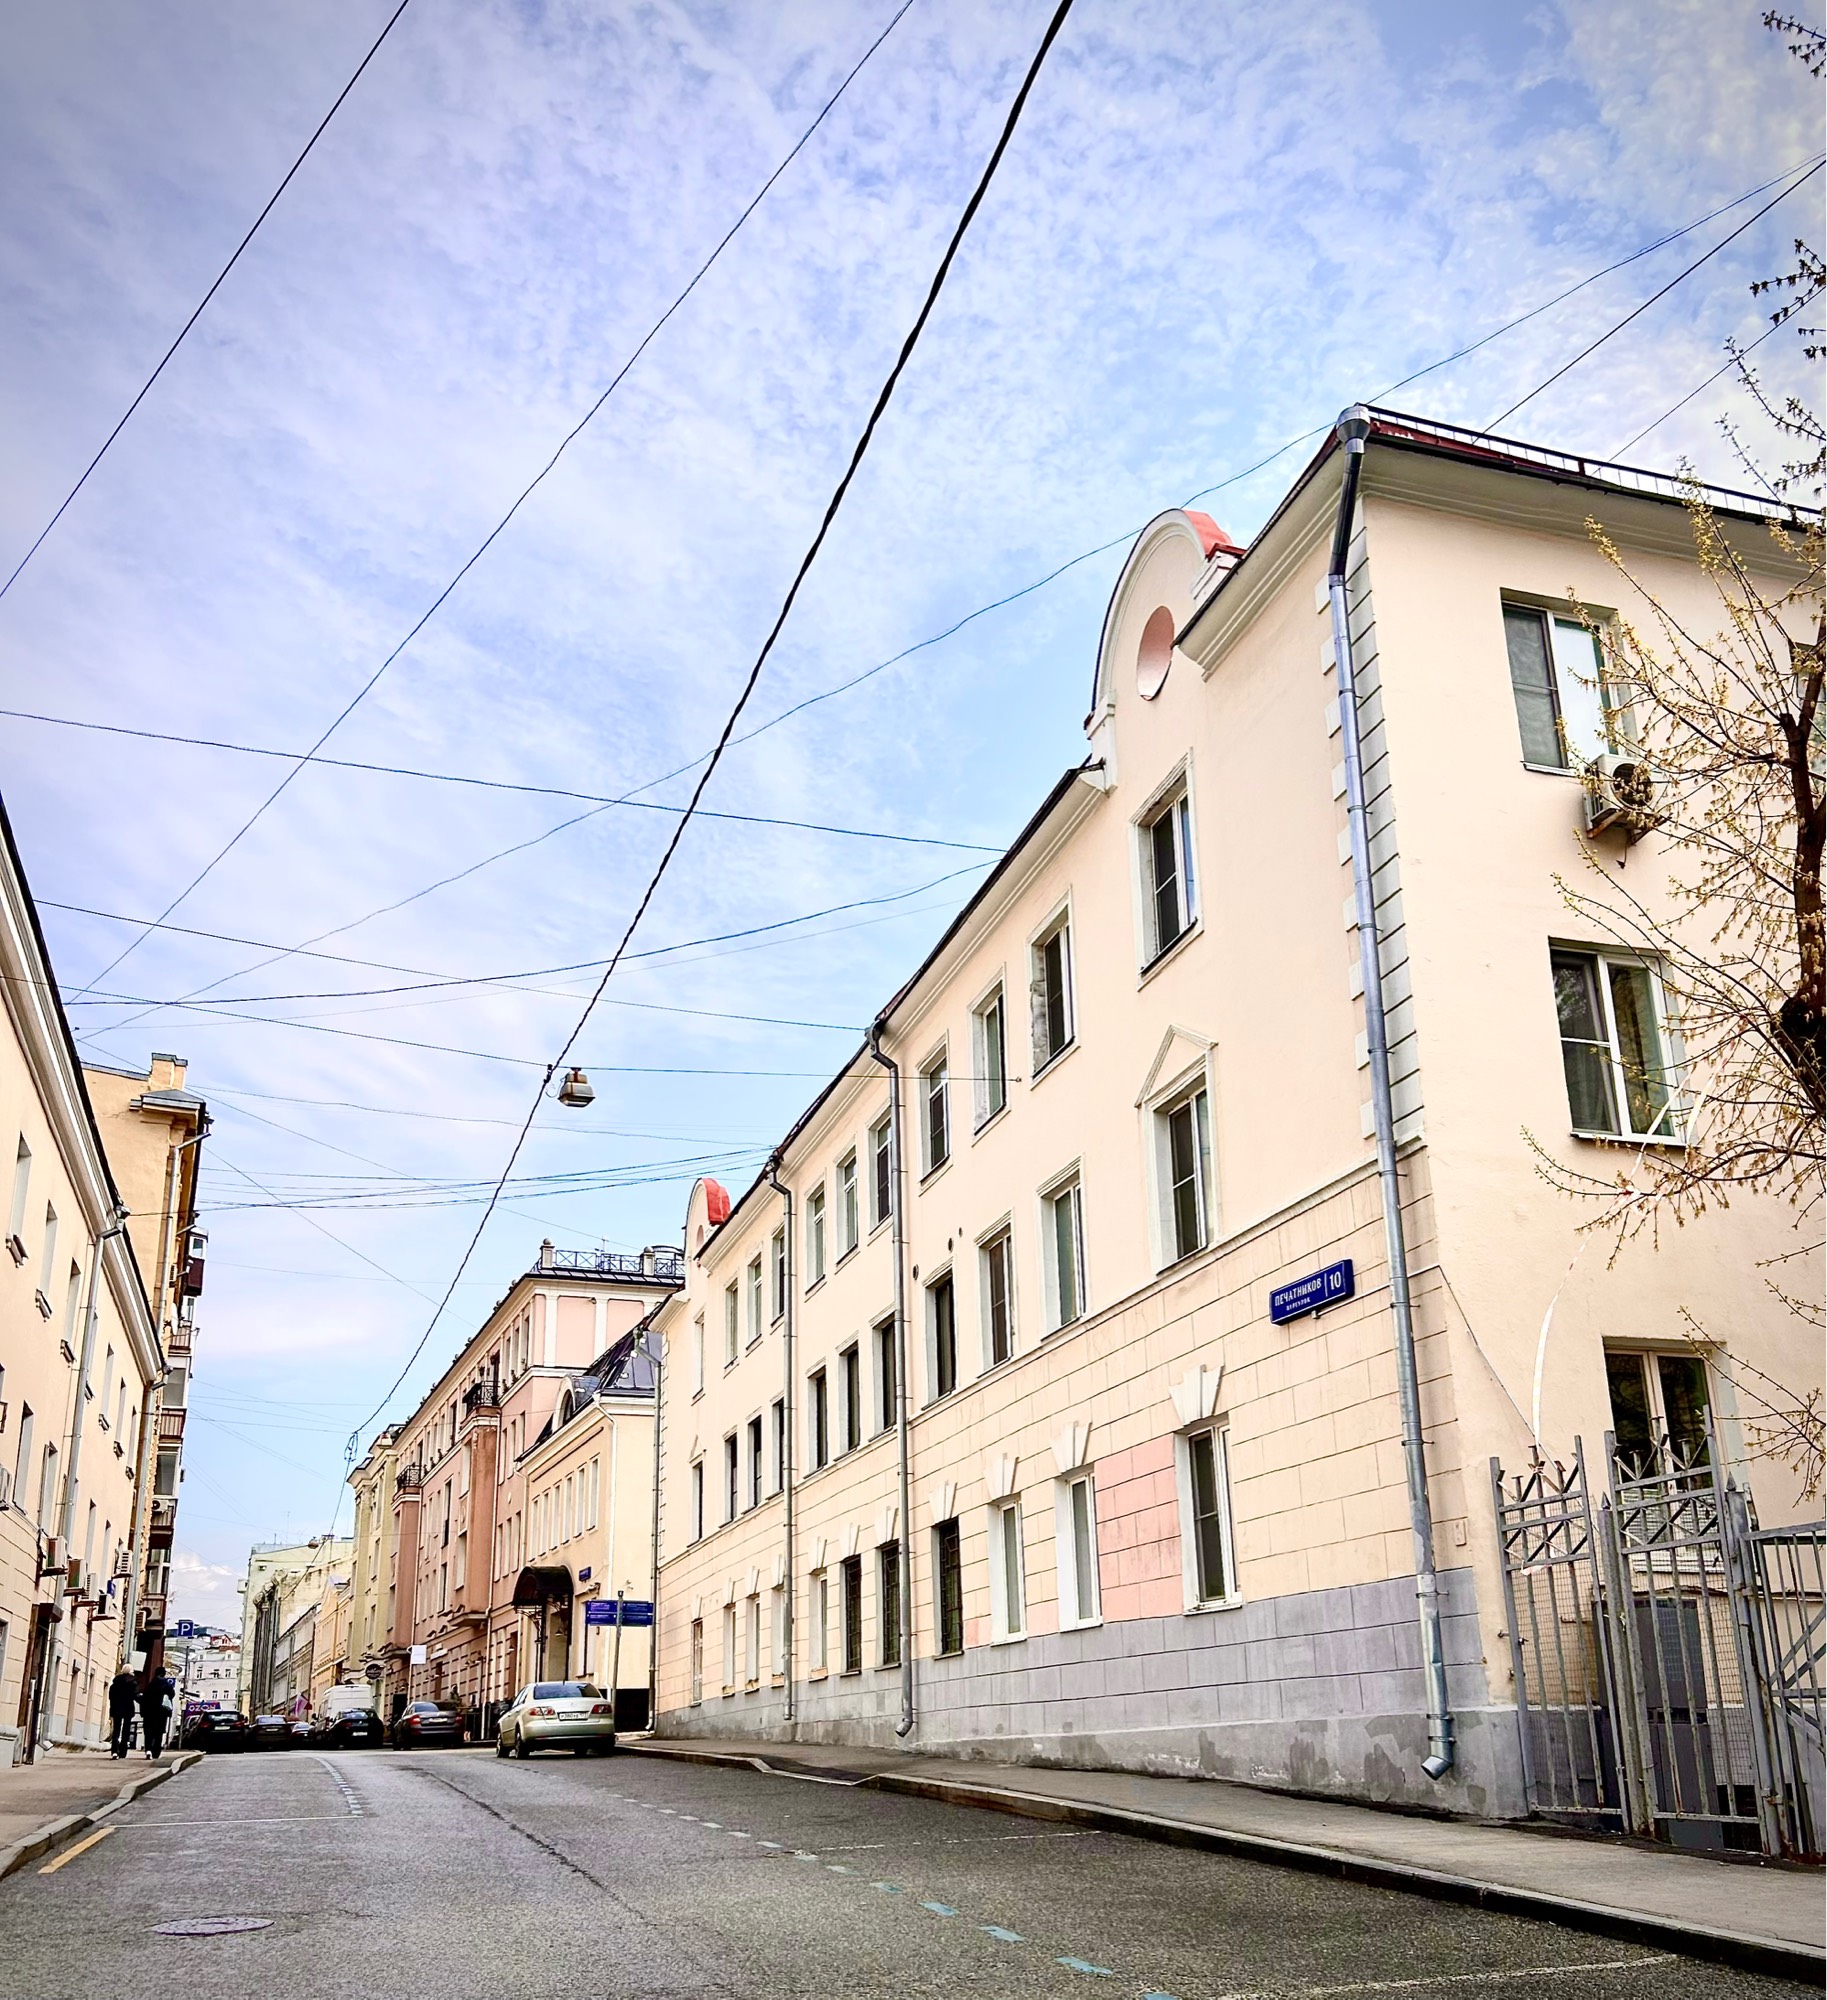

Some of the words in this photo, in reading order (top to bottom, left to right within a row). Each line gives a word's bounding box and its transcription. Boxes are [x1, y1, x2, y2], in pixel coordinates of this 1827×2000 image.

[1274, 1278, 1322, 1306] ПЕЧАТНИКОВ
[1329, 1271, 1342, 1290] 10
[181, 1623, 191, 1636] P
